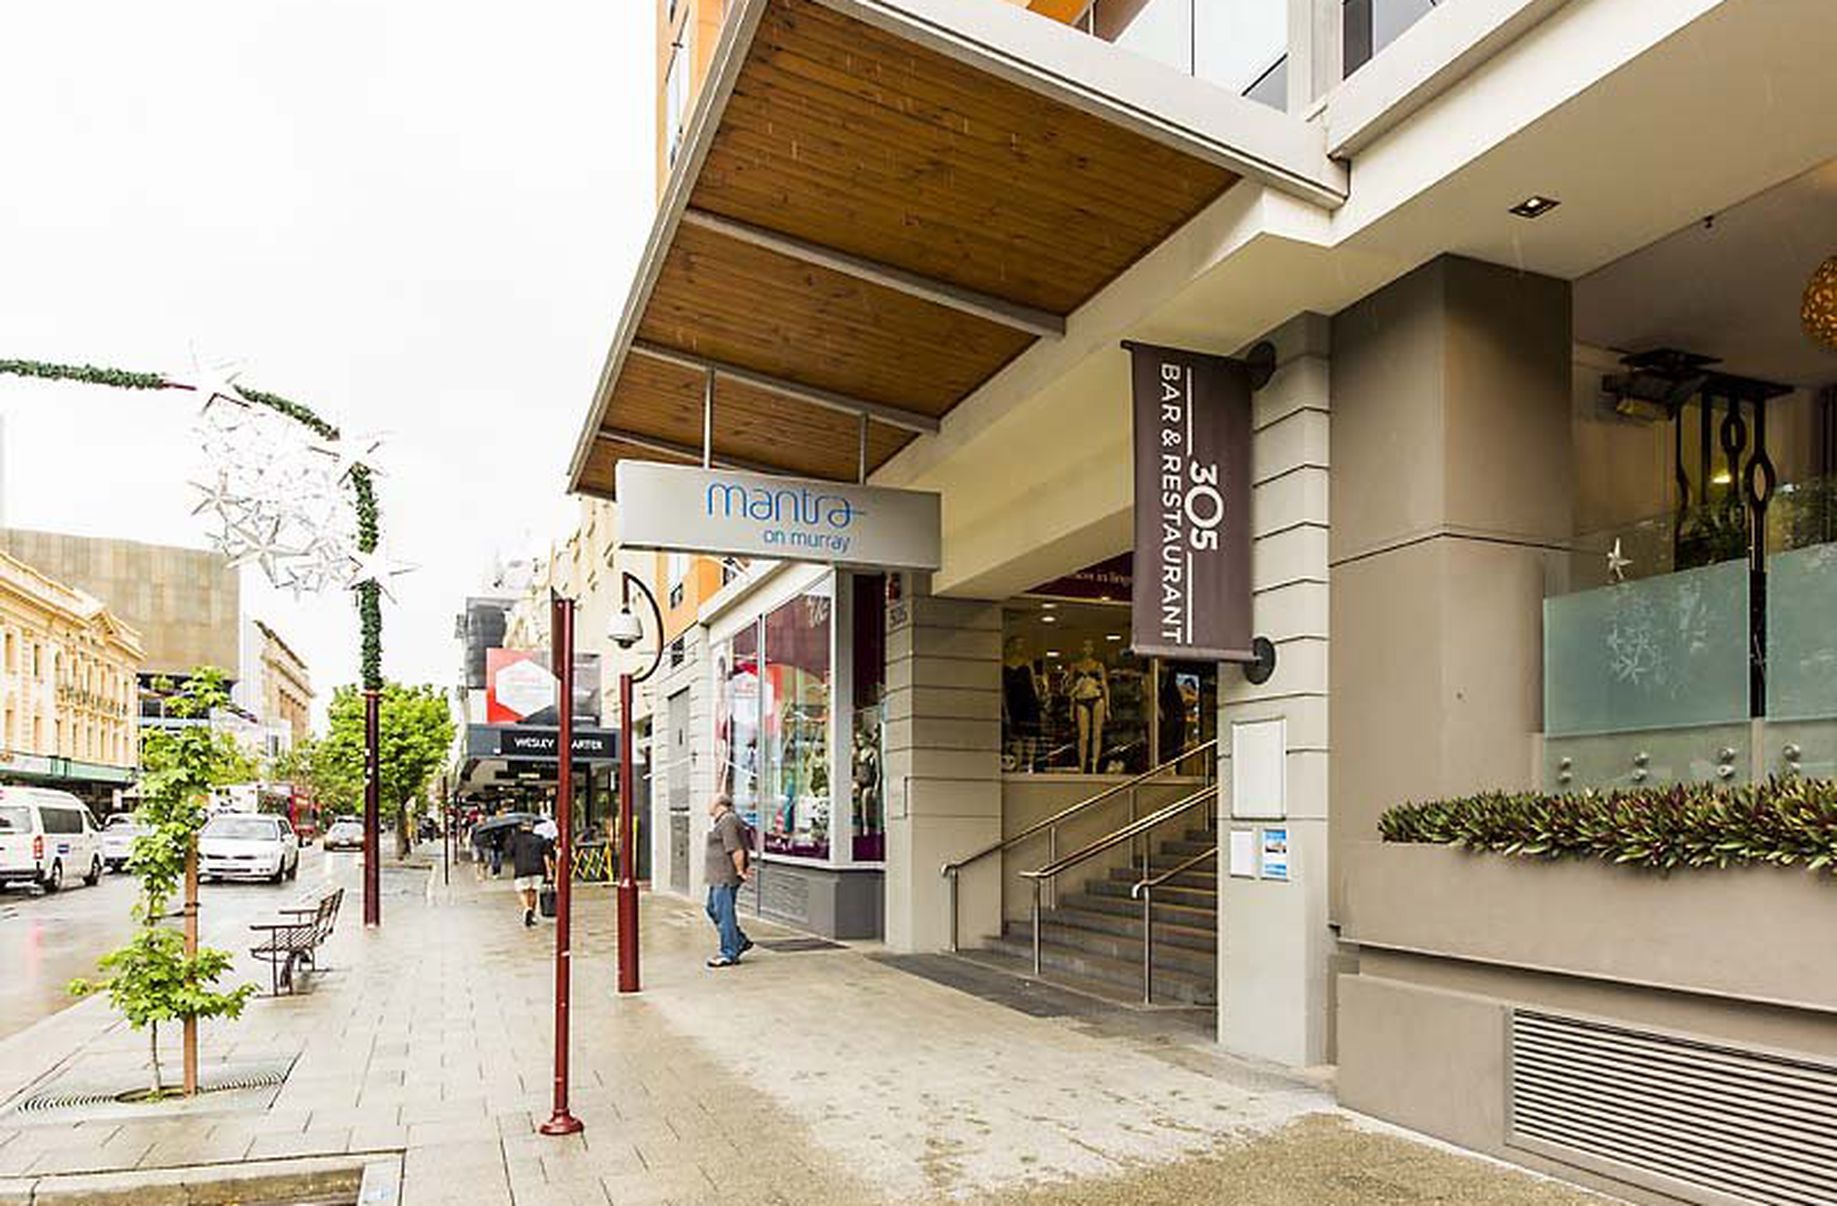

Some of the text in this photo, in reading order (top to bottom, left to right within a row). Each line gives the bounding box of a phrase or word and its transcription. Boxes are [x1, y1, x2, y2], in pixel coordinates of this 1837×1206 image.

[707, 482, 866, 529] mantra
[1160, 363, 1183, 645] BAR & RESTAURANT
[1184, 460, 1225, 551] 305
[762, 529, 850, 553] on murray
[513, 736, 604, 751] WESLEY ARTER
